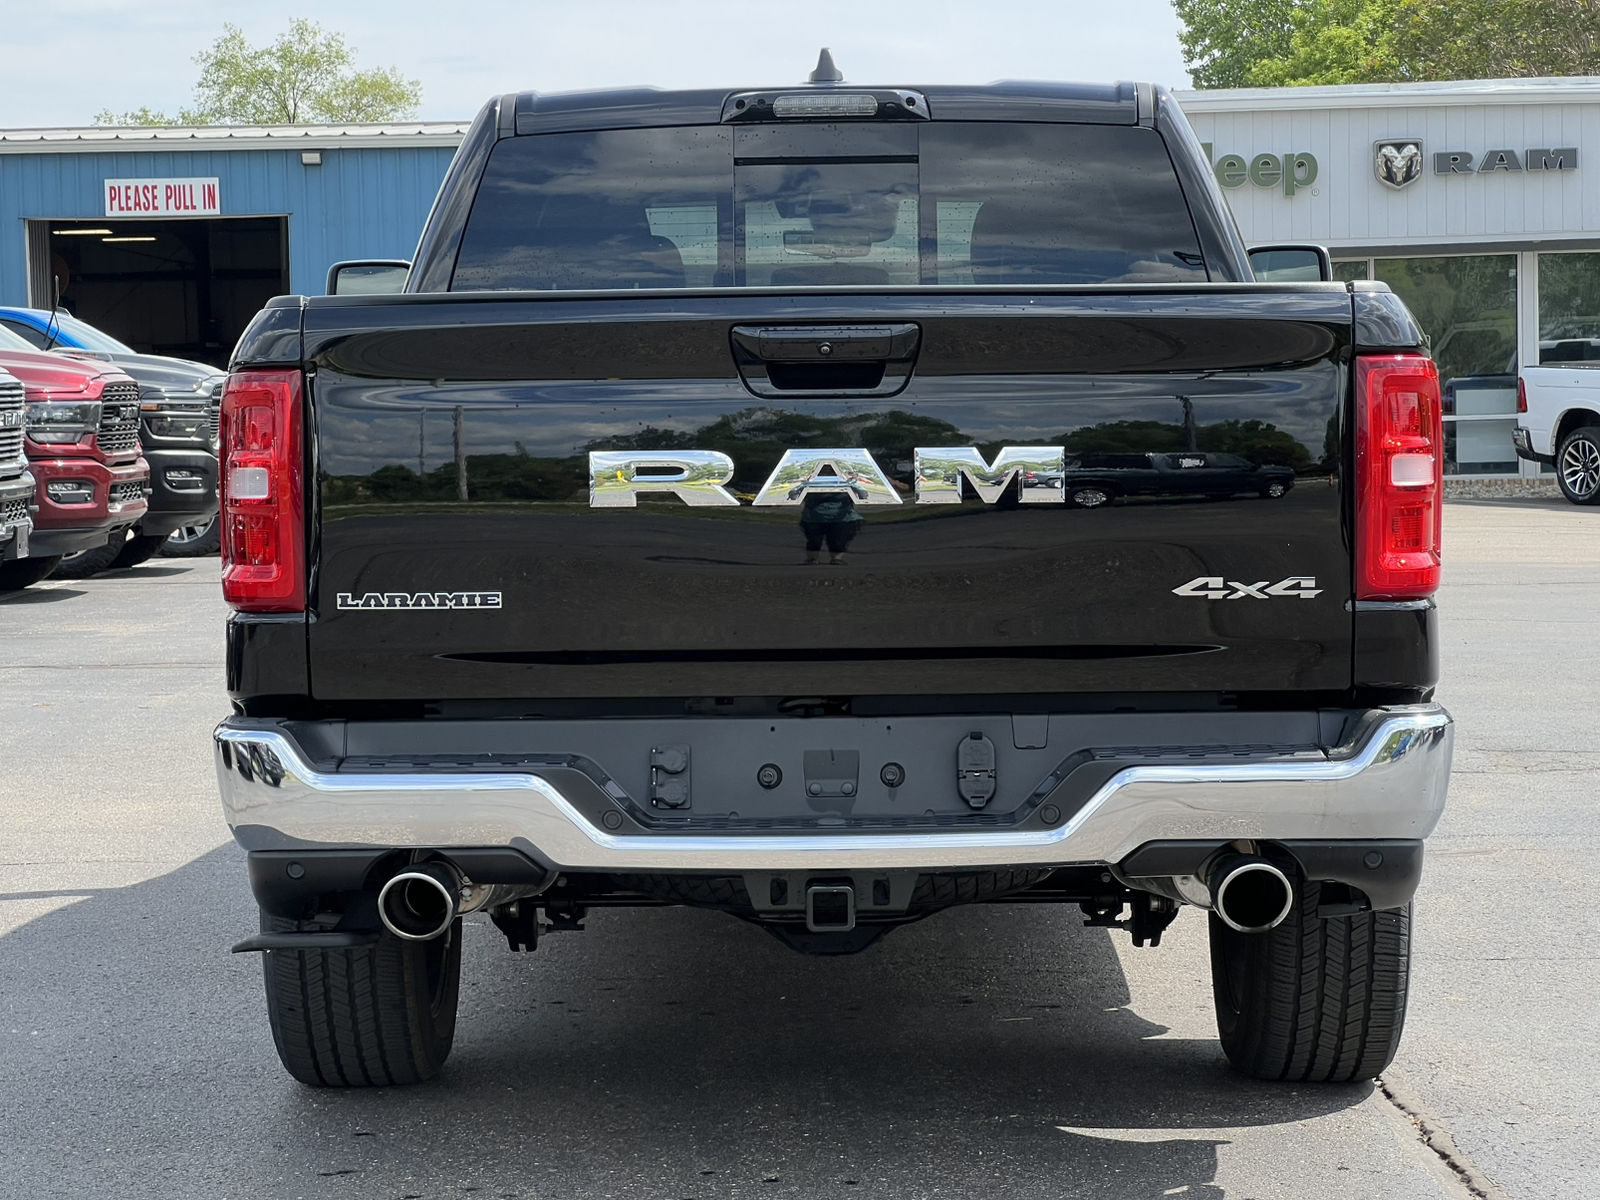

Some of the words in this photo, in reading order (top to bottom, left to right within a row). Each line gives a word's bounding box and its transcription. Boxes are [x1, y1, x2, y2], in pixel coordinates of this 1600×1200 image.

[1434, 147, 1579, 175] RAM
[109, 185, 159, 211] PLEASE
[165, 184, 197, 211] PULL
[202, 183, 216, 210] IN
[589, 446, 1066, 508] RAM
[337, 592, 502, 610] LARAMIE
[1171, 576, 1324, 599] 4x4
